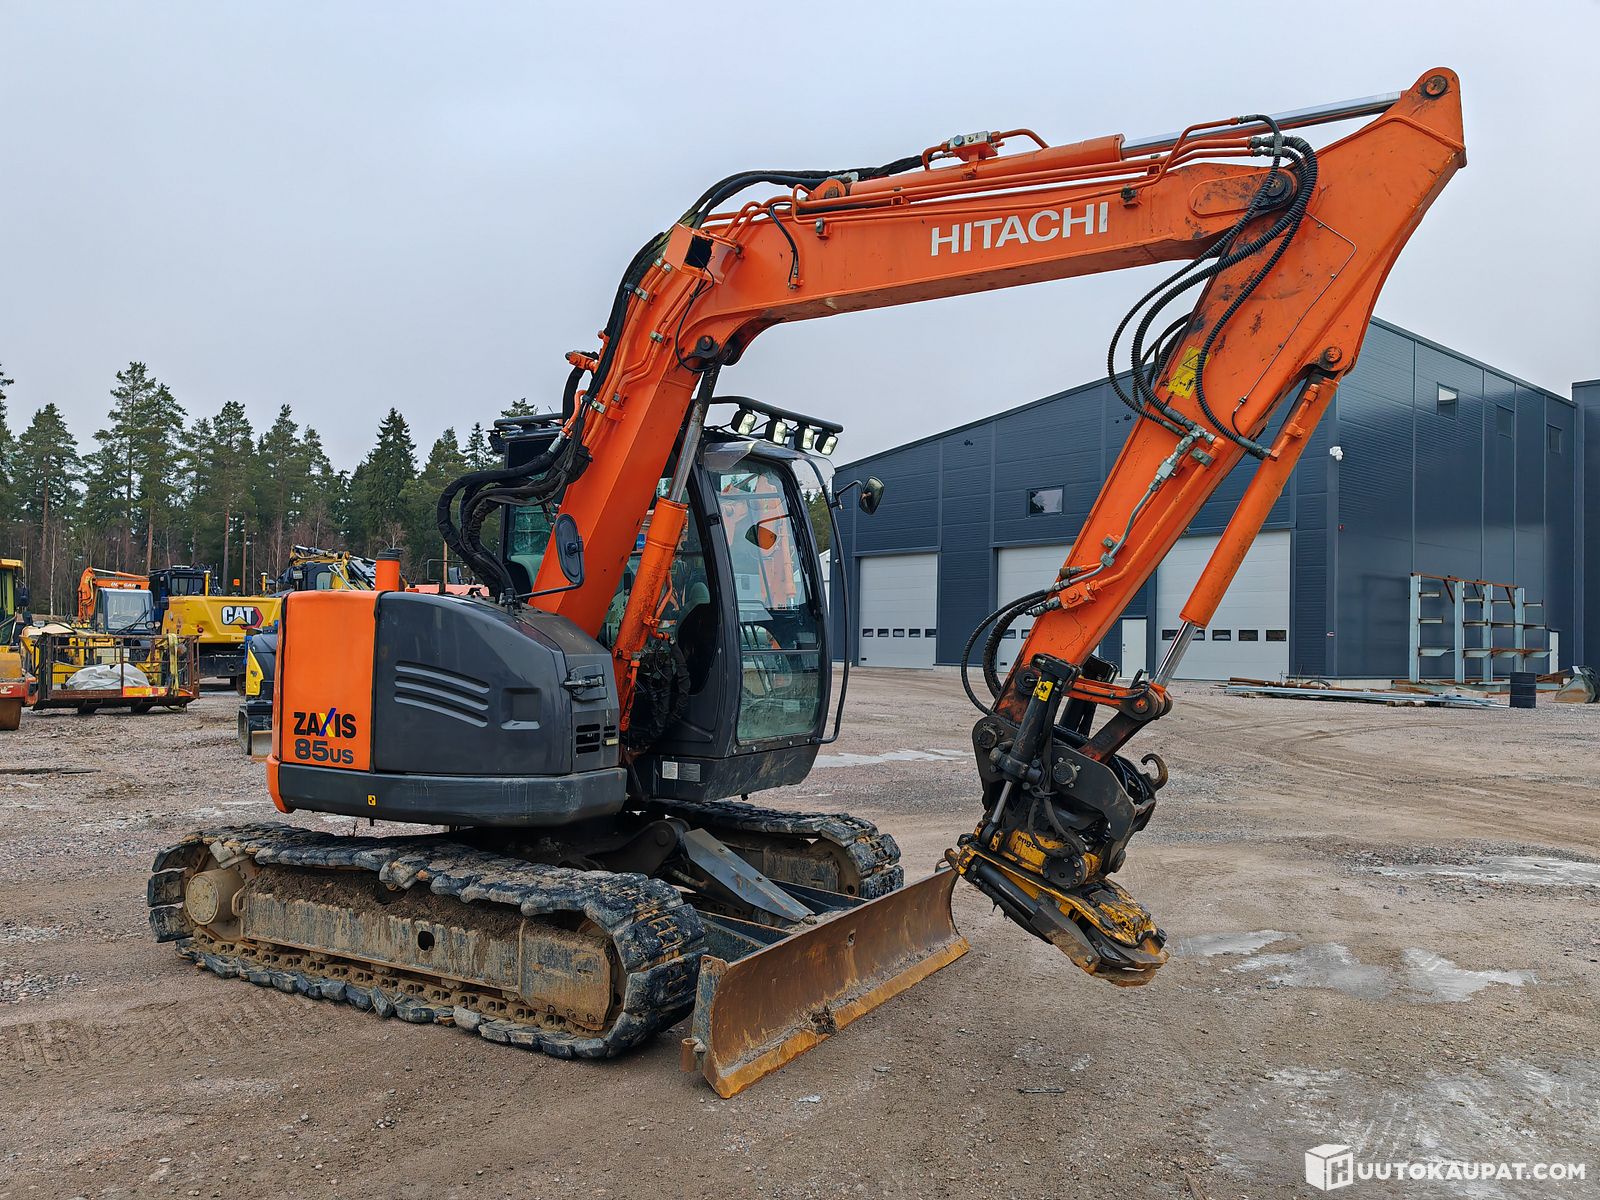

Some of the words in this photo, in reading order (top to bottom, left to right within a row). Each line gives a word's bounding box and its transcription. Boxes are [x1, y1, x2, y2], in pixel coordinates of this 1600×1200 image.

[931, 201, 1109, 256] HITACHI
[222, 606, 254, 625] CAT
[293, 707, 357, 739] ZAXIS
